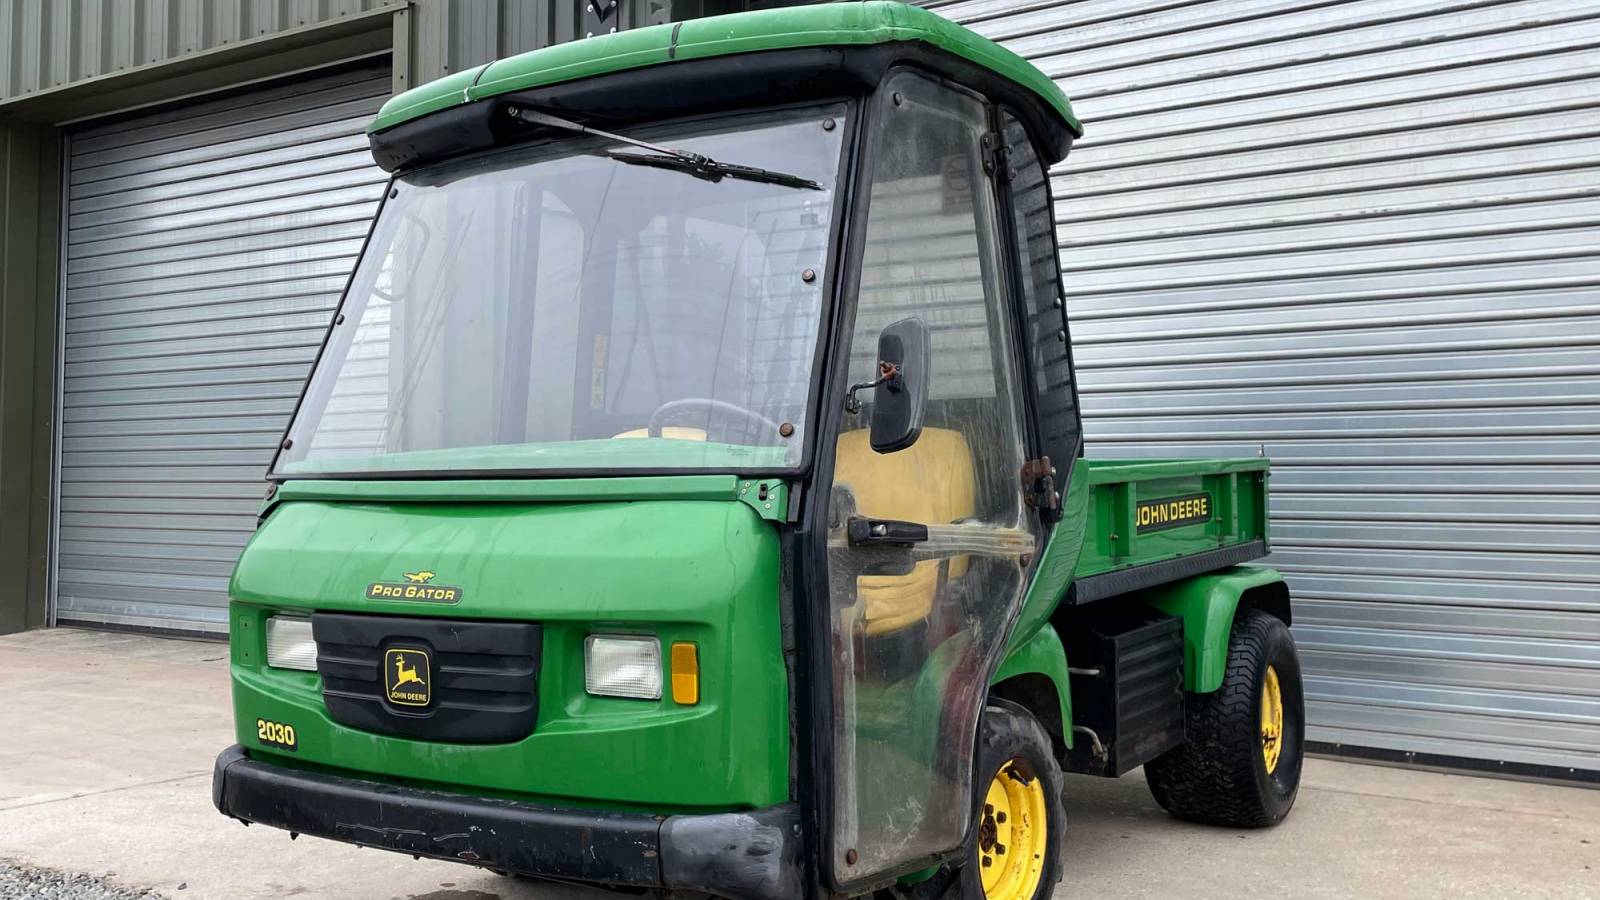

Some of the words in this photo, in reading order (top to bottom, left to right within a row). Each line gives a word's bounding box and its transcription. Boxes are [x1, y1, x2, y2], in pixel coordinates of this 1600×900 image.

[1136, 504, 1168, 527] JOHN
[1170, 498, 1207, 520] DEERE
[371, 584, 402, 598] PRO
[405, 586, 455, 600] GATOR
[390, 691, 406, 699] JOHN
[407, 692, 427, 701] DEERE
[257, 719, 295, 746] 2030
